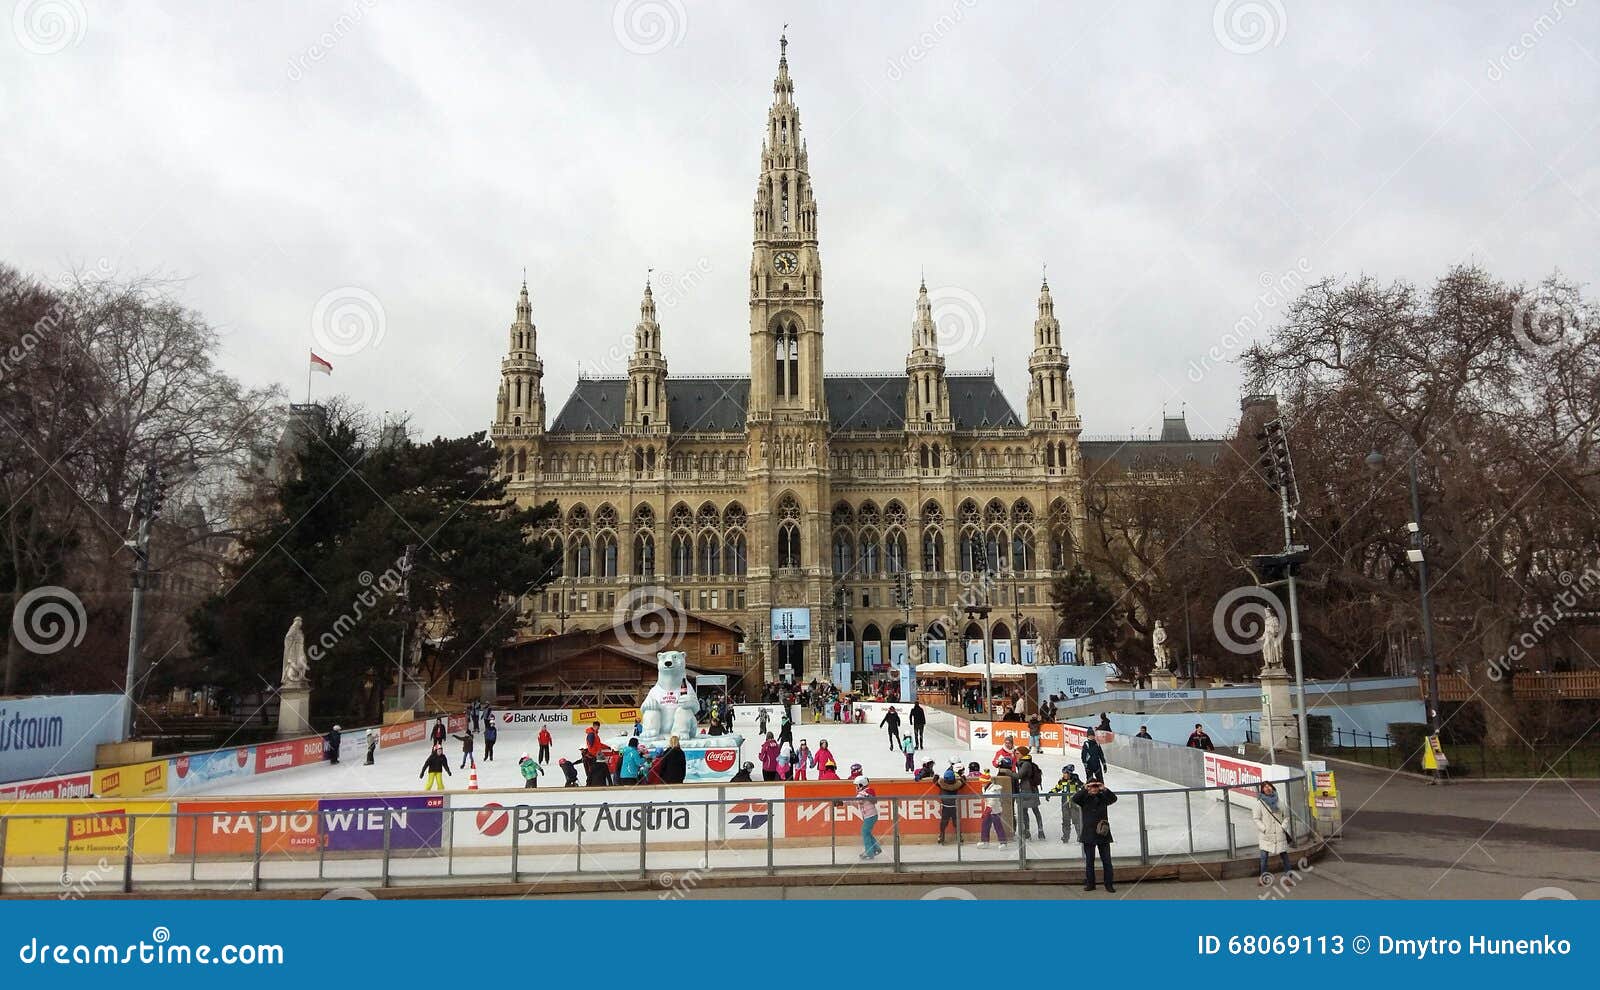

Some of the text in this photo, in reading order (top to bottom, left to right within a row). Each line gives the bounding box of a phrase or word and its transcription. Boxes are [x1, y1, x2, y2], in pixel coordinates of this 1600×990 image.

[514, 712, 568, 723] Bank Austria
[0, 709, 63, 751] istraum
[706, 751, 735, 764] Coca-Cola
[72, 816, 122, 836] BILLA
[212, 807, 408, 835] RADIO WIEN
[517, 802, 690, 834] Bank Austria
[290, 837, 316, 846] RADIO
